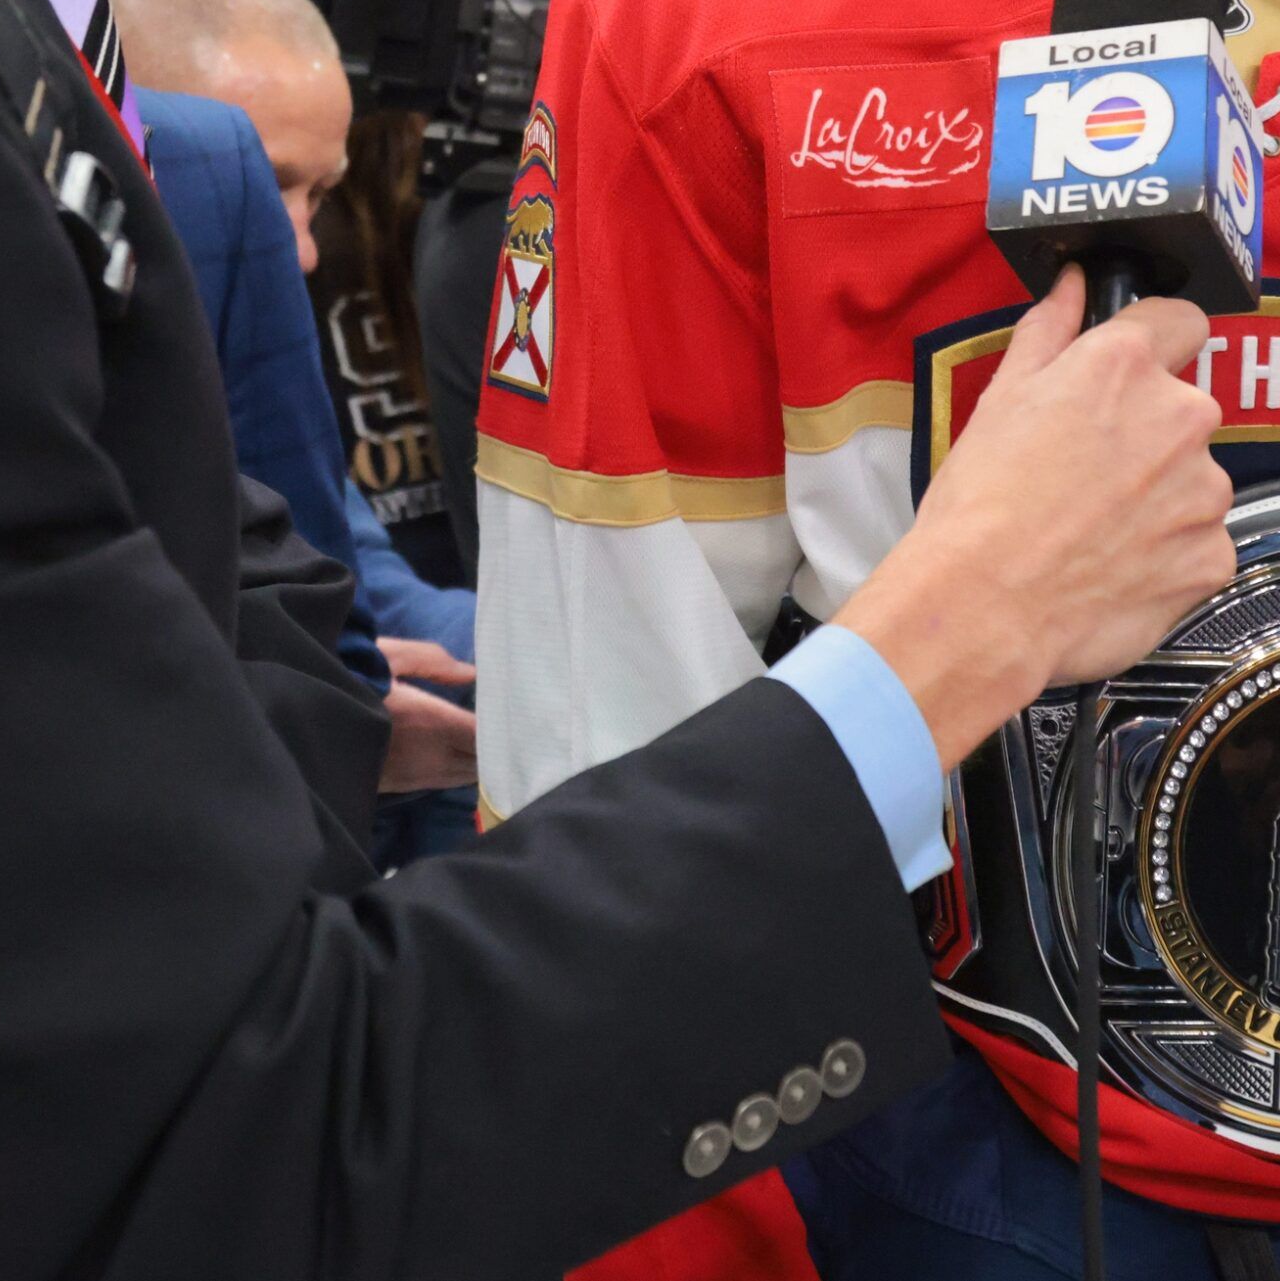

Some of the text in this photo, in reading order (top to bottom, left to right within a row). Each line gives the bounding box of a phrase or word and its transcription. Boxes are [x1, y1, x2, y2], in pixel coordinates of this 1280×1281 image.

[1048, 33, 1157, 66] Local
[1222, 58, 1253, 128] Local
[1024, 71, 1175, 181] 10
[1216, 93, 1256, 235] 10
[1021, 176, 1170, 217] NEWS
[1213, 192, 1254, 283] NEWS
[1160, 909, 1268, 1034] STANLEY
